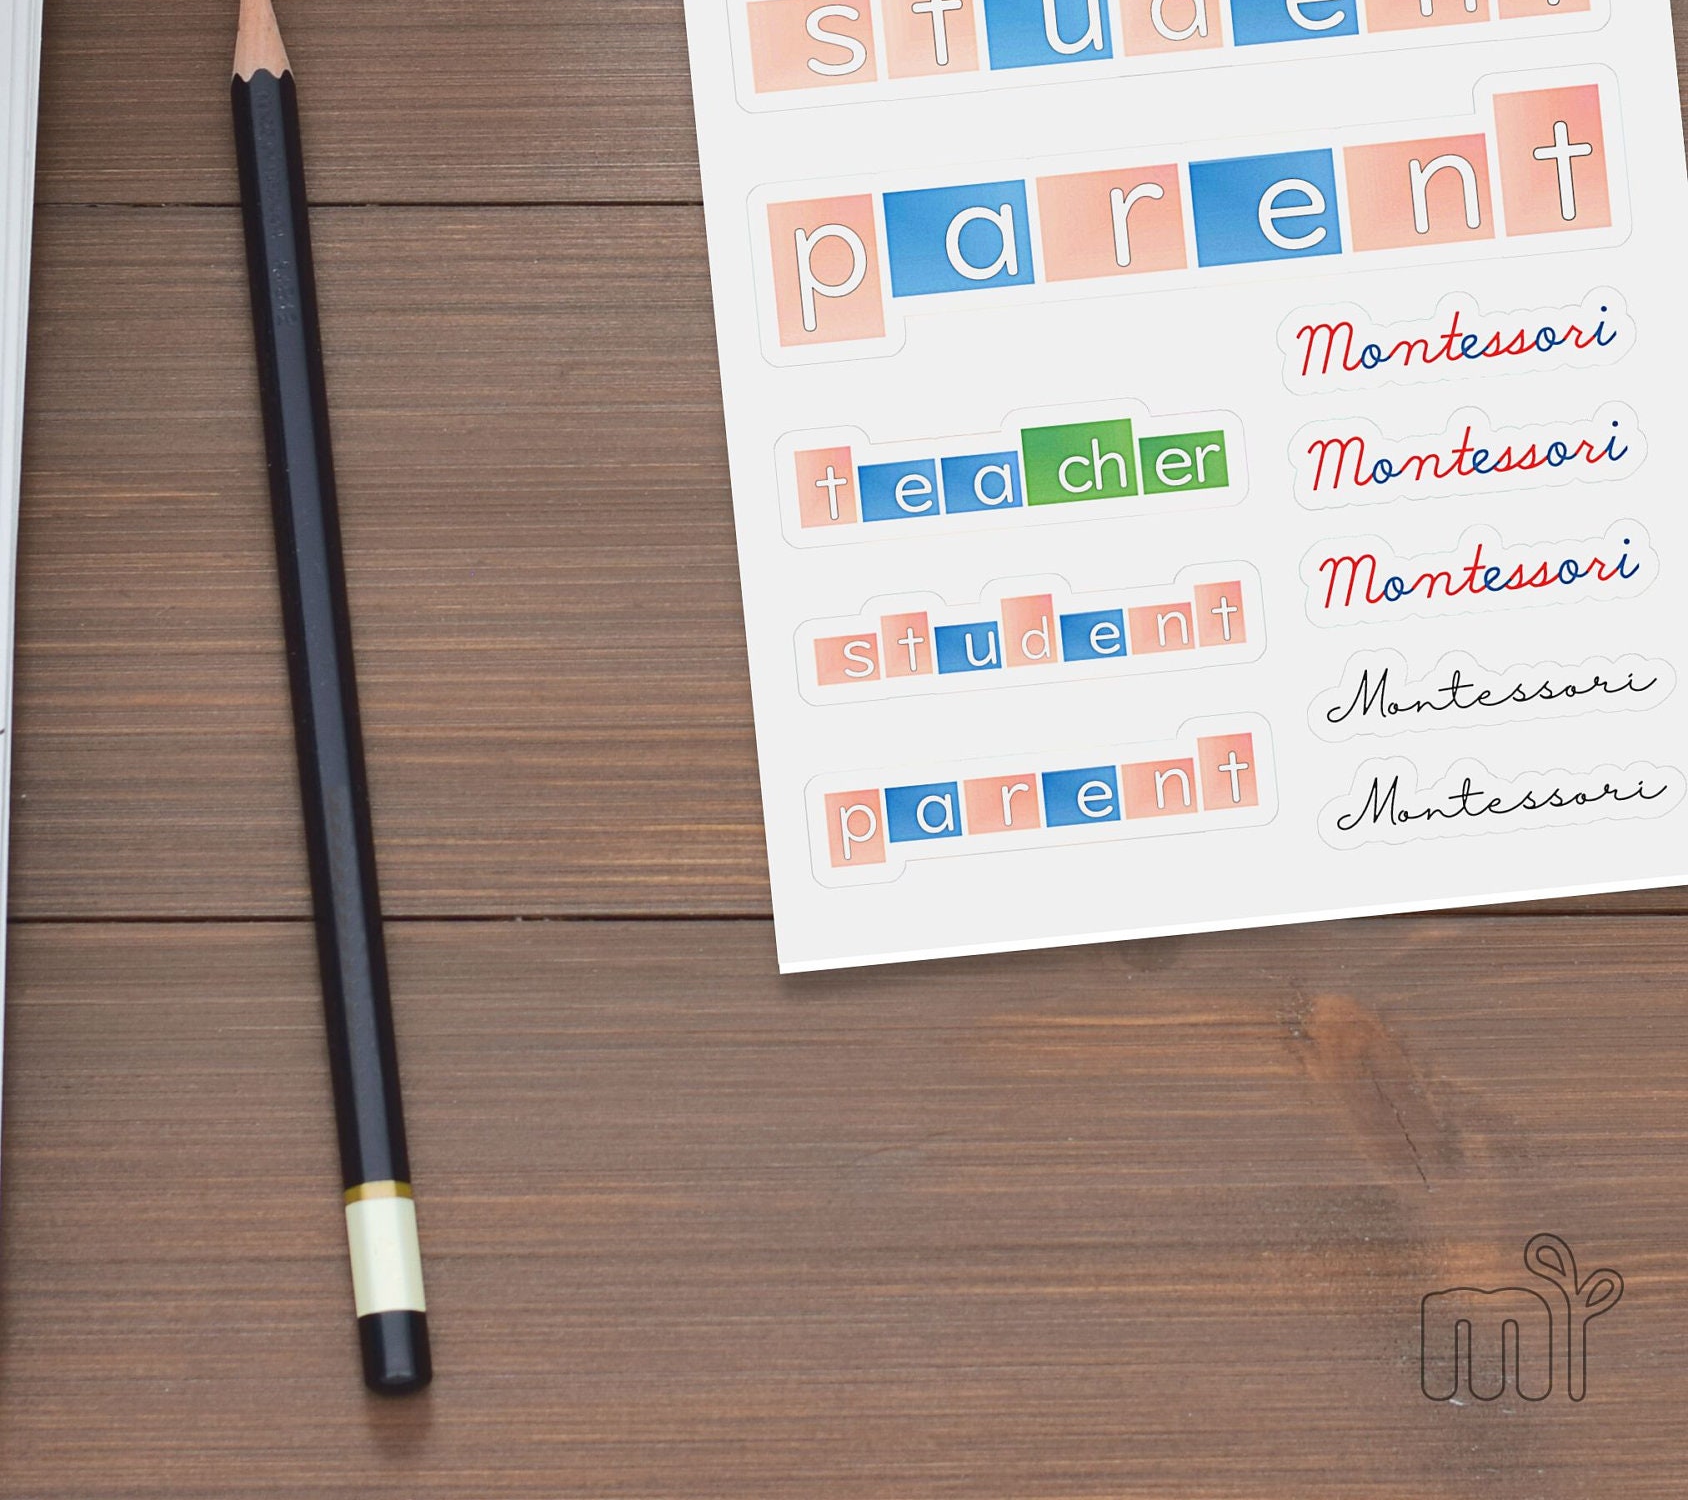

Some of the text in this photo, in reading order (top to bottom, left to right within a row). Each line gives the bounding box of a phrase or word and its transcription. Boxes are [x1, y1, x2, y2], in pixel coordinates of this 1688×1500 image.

[794, 120, 1593, 332] parent
[1296, 305, 1617, 376] Montessori
[815, 438, 1220, 520] teacher
[1307, 420, 1628, 491] Montessori
[1319, 538, 1640, 609] Montessori
[842, 596, 1238, 679] student
[1326, 667, 1657, 723] Montessori
[839, 751, 1250, 861] parent
[1337, 775, 1668, 831] Montessori
